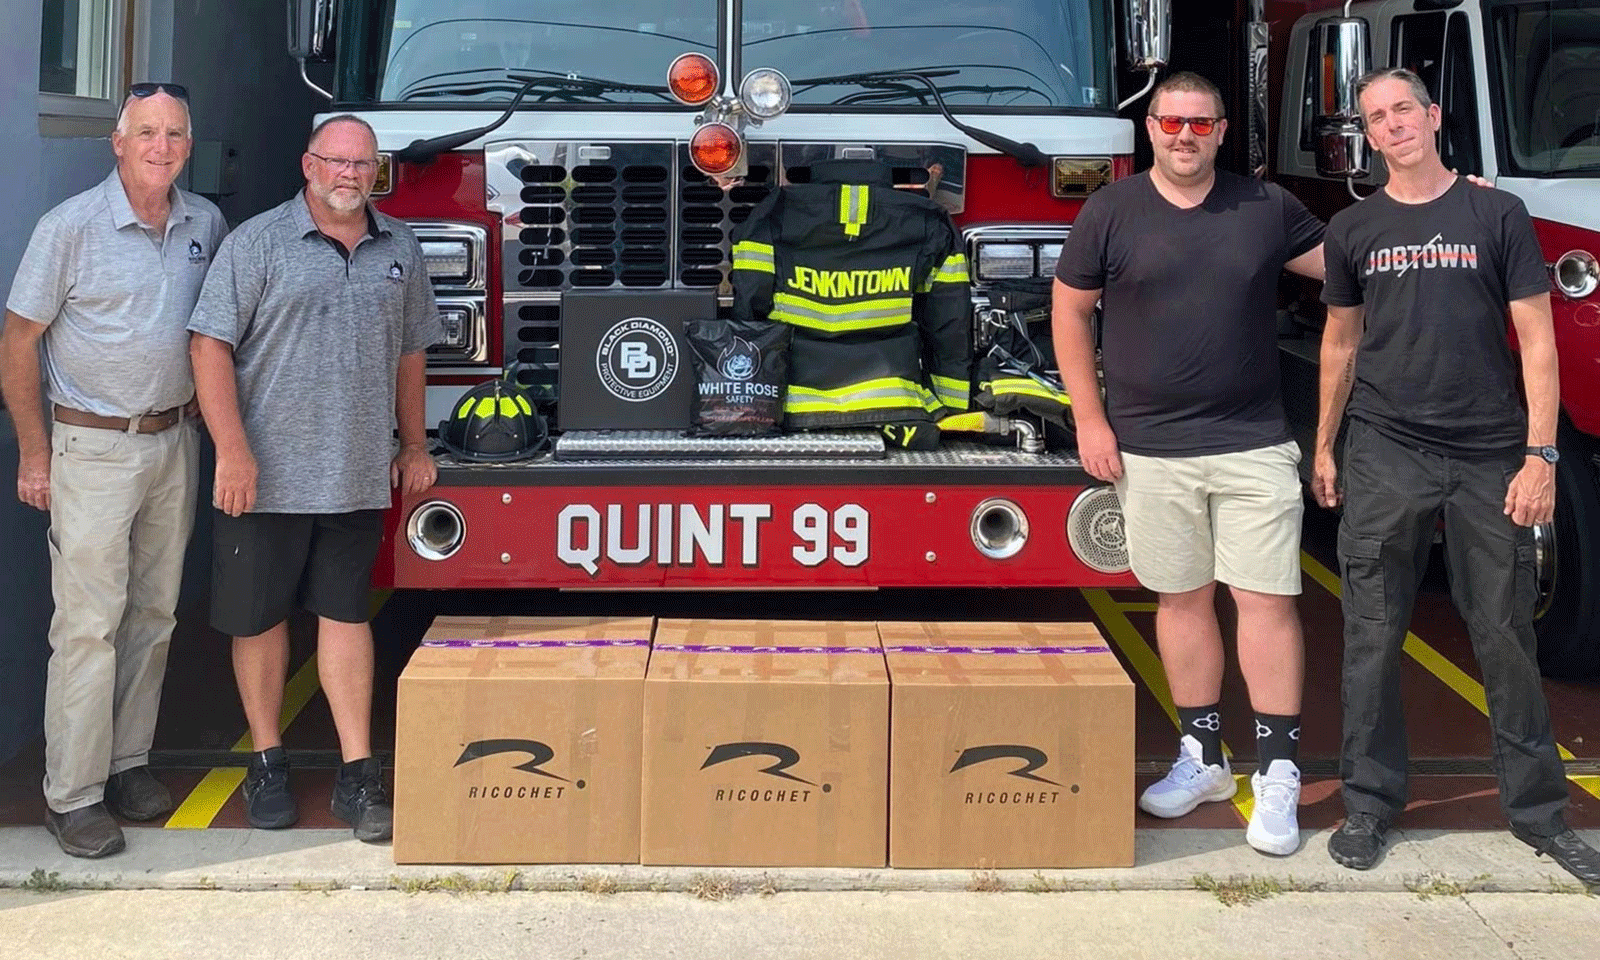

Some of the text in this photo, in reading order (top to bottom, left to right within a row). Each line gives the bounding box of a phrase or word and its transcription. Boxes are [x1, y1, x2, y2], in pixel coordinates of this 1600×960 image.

[1365, 243, 1478, 276] JOBTOWN
[787, 265, 911, 298] JENKINTOWN
[601, 323, 630, 356] BLACK
[601, 362, 675, 398] PROTECTIVE EQUIPMENT
[698, 382, 779, 398] WHITE ROSE
[725, 395, 755, 404] SAFETY
[557, 502, 870, 576] QUINT 99
[468, 786, 565, 799] RICOCHET
[715, 789, 811, 802] RICOCHET
[965, 791, 1059, 804] RICOCHET
